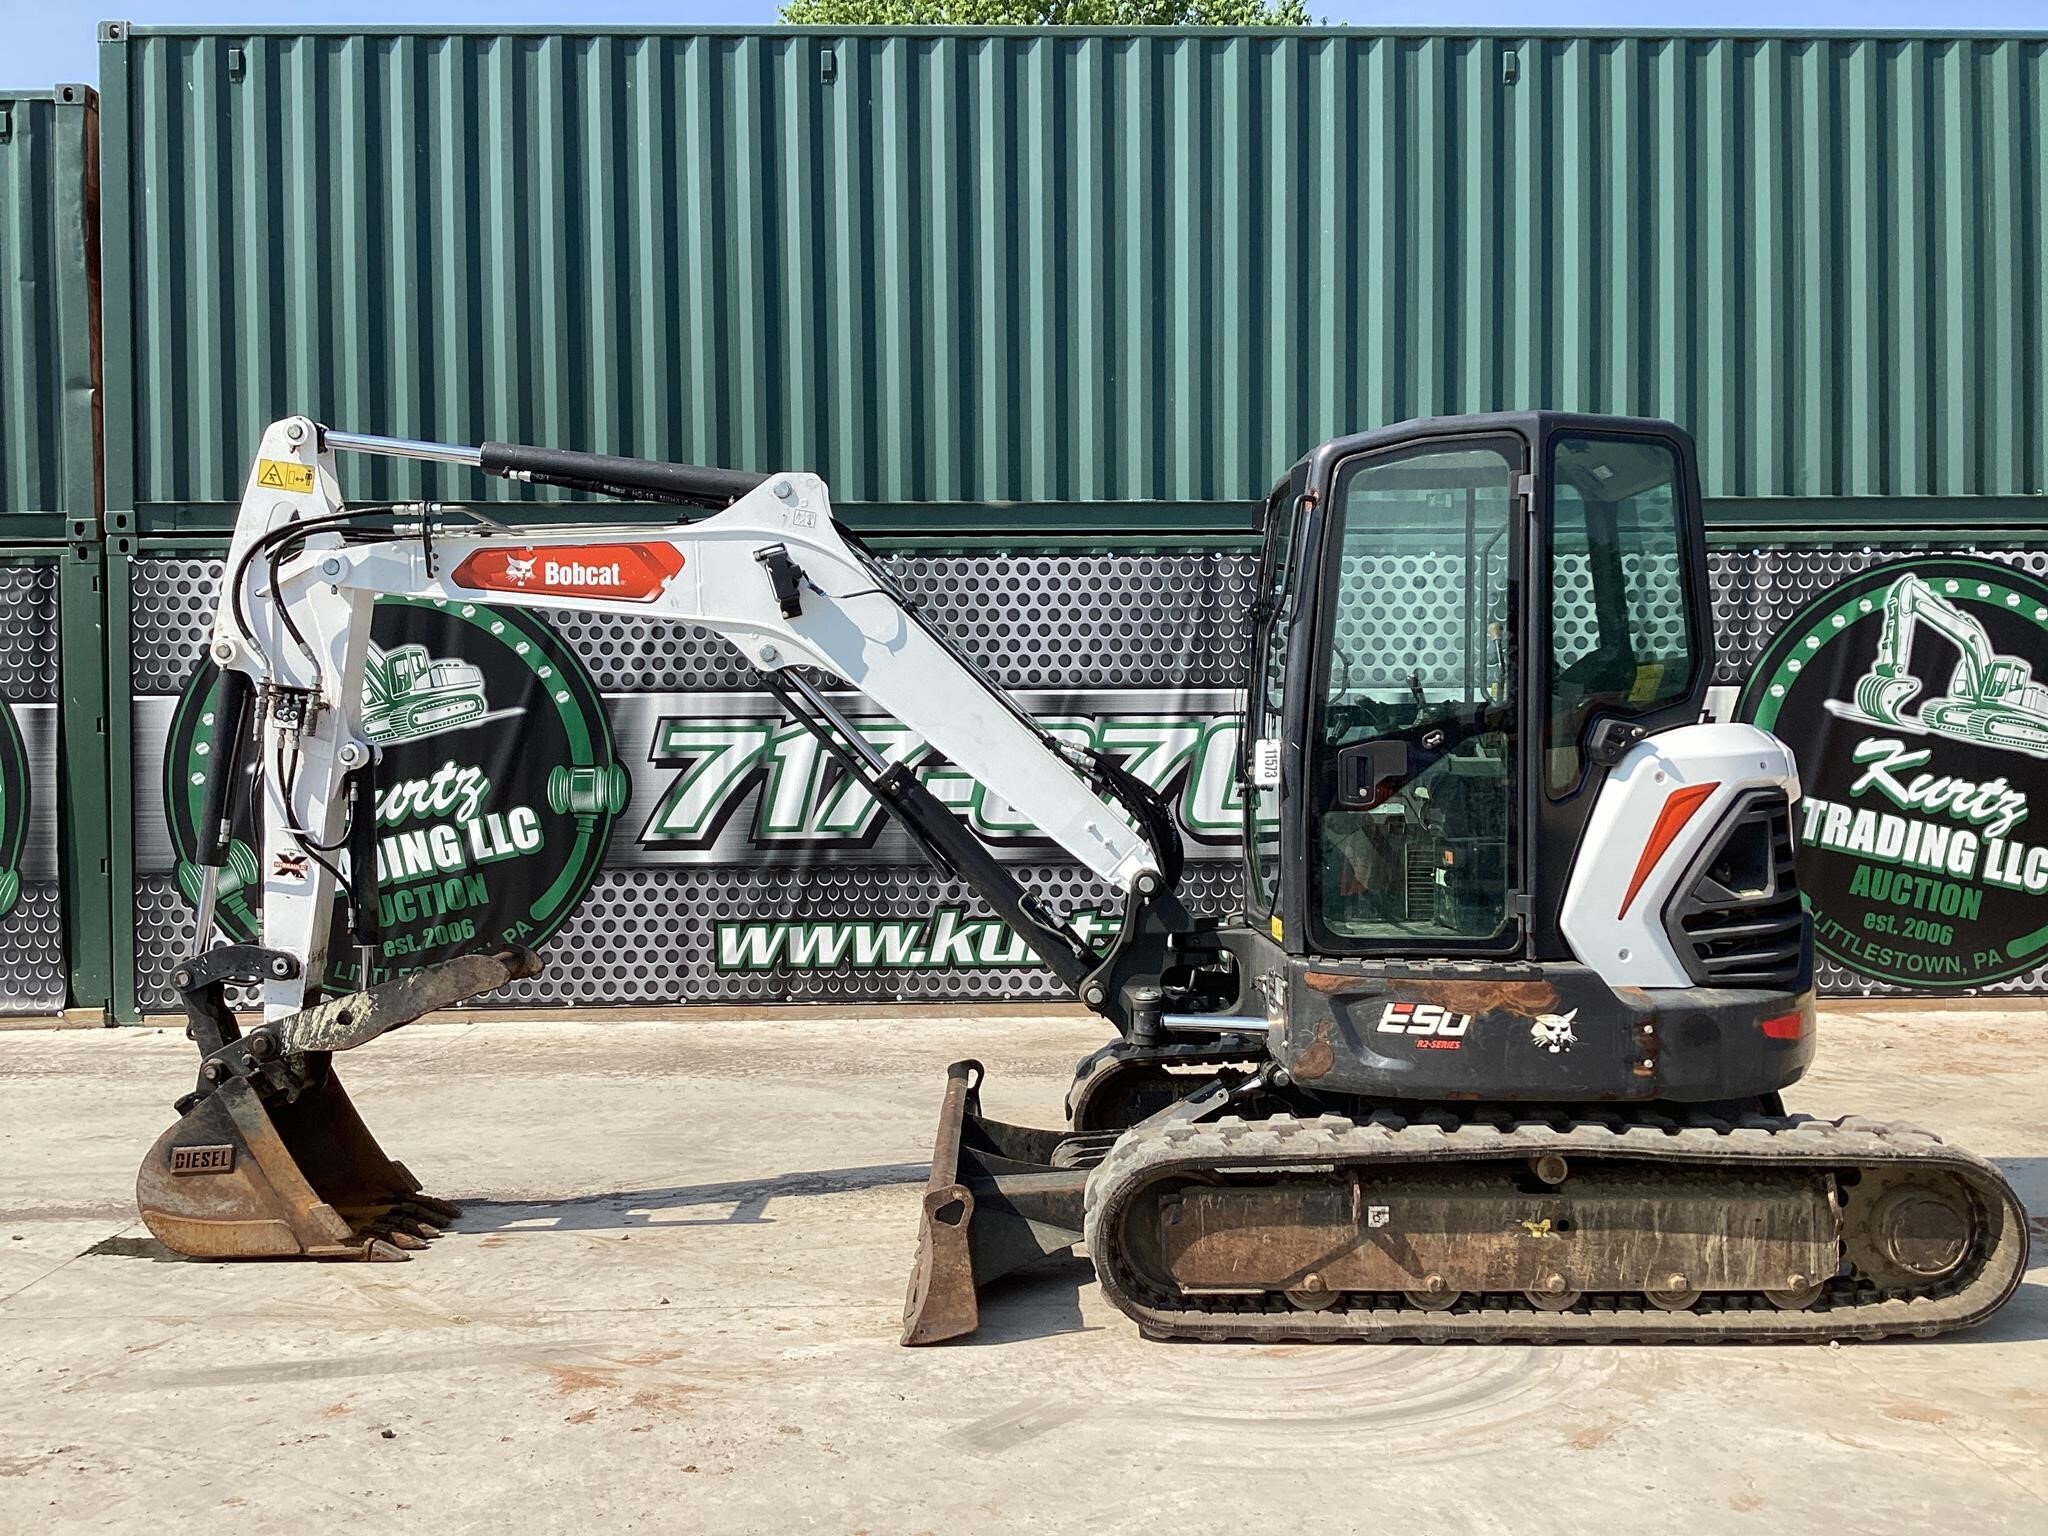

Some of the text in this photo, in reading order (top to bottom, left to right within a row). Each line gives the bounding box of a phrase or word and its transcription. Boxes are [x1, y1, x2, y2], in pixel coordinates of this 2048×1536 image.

[544, 561, 621, 586] Bobcat
[1264, 748, 1278, 778] 11573
[375, 760, 489, 825] urtz
[1850, 736, 2029, 842] Kurtz
[467, 806, 542, 862] LLC
[1802, 796, 2048, 892] TRADING LLC
[378, 873, 490, 928] UCTION
[1849, 863, 1984, 921] AUCTION
[383, 917, 476, 958] est. 2006
[502, 920, 535, 945] PA
[1863, 910, 1954, 946] est. 2006
[1973, 948, 2004, 970] PA
[174, 1150, 228, 1169] DIESEL
